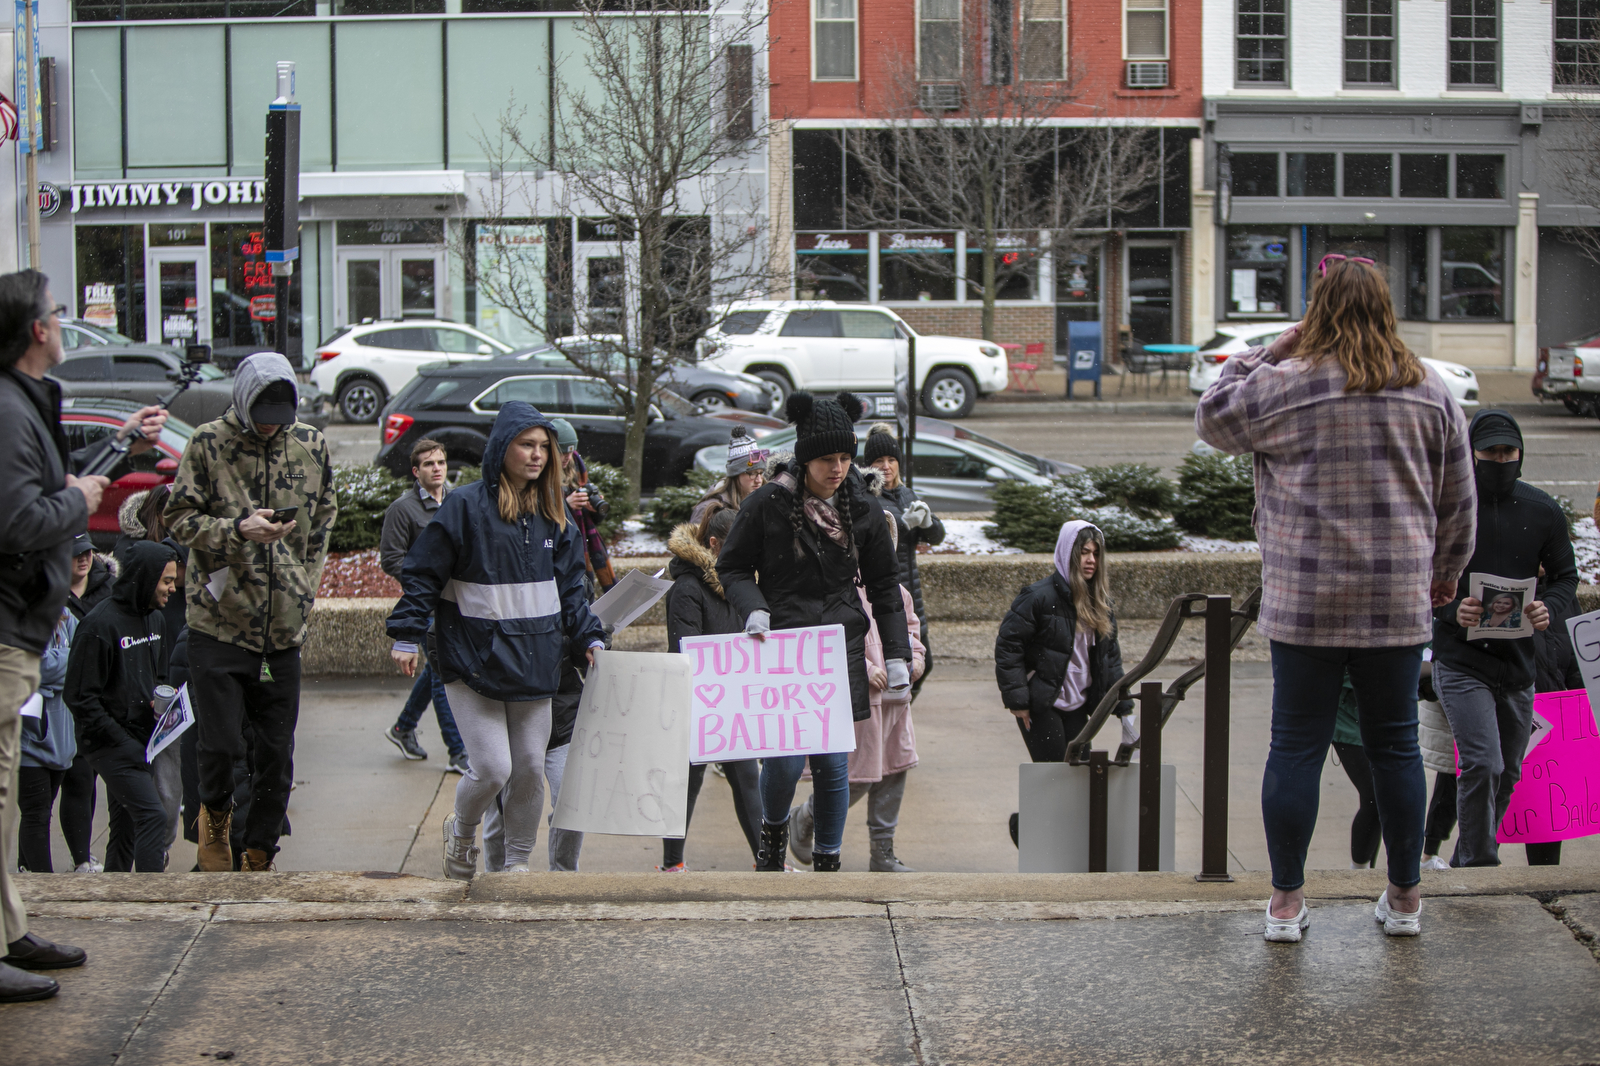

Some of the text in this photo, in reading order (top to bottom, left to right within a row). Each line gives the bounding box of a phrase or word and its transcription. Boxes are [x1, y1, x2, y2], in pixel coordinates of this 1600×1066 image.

[70, 183, 182, 213] JIMMY
[167, 229, 187, 241] 101
[381, 232, 402, 243] 001
[595, 224, 617, 235] 102
[506, 235, 543, 244] LEASE
[813, 233, 851, 250] Tacos
[889, 233, 946, 249] Burritos
[84, 285, 115, 298] FREE
[120, 633, 161, 649] Chamion
[686, 629, 838, 676] JUSTICE
[742, 683, 806, 710] FOR
[698, 707, 831, 756] BAILEY
[1501, 808, 1538, 838] ur
